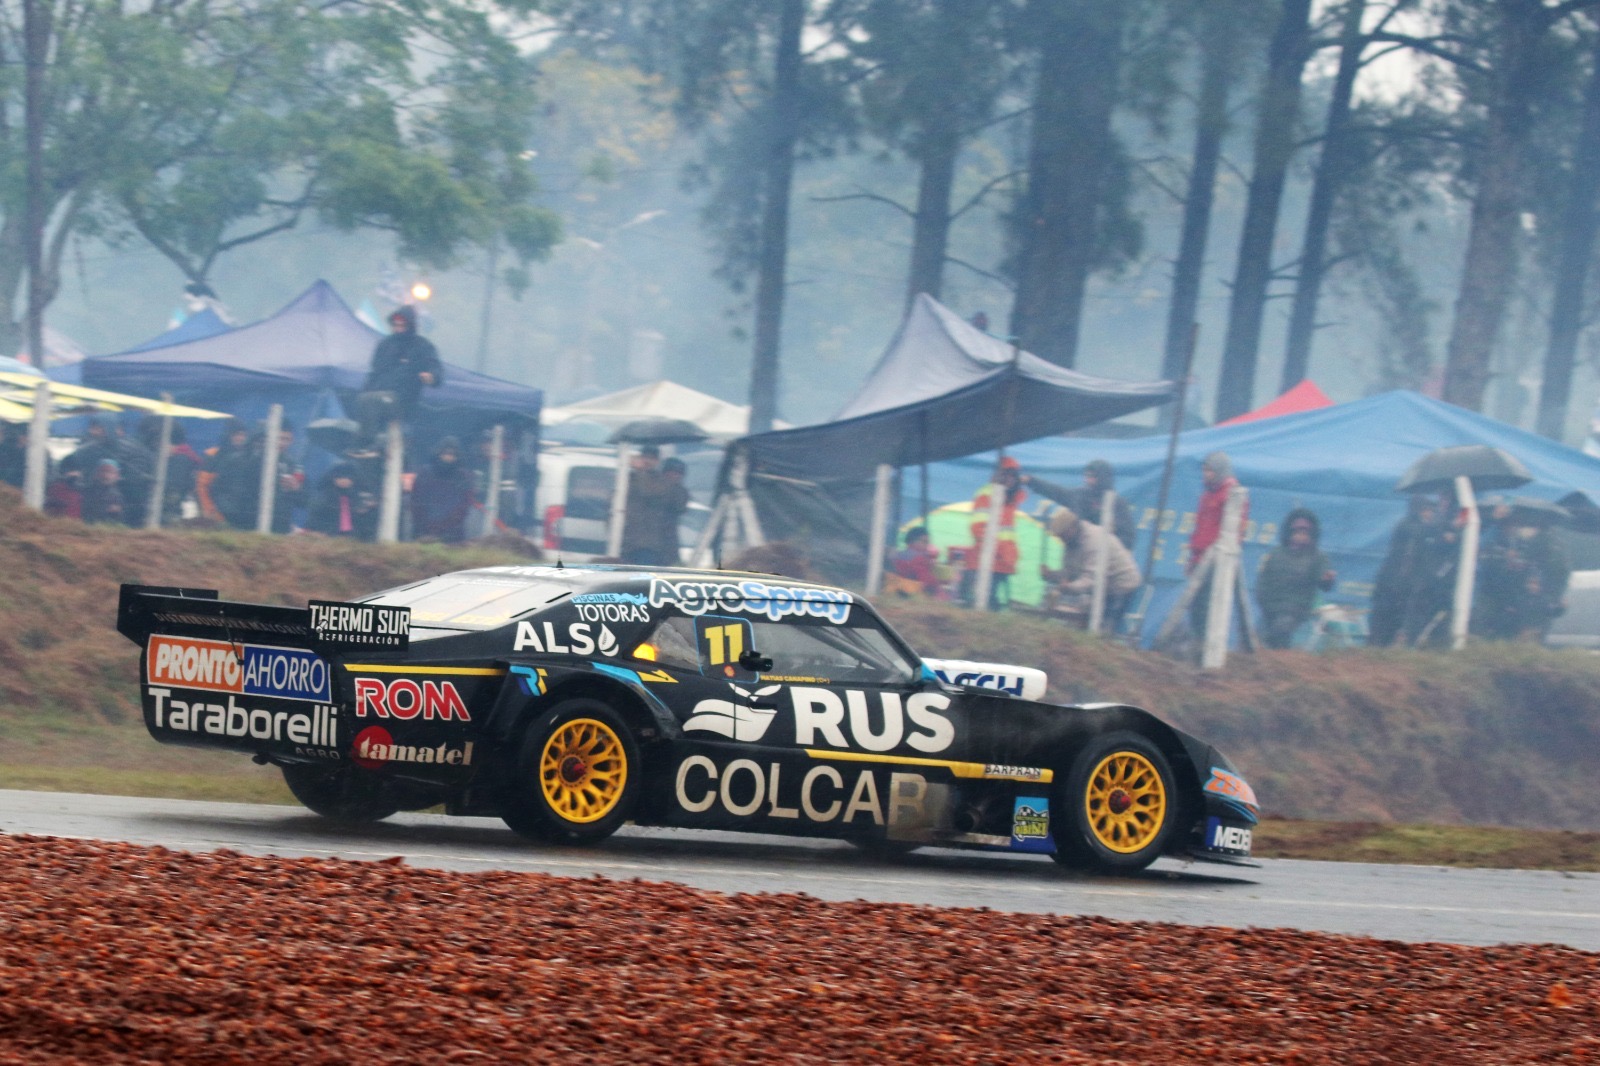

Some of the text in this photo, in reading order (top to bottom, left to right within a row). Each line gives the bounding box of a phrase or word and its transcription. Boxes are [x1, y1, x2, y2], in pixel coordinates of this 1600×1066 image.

[309, 604, 374, 633] THERMO
[377, 609, 410, 635] SUR
[572, 593, 616, 603] PISCINAS
[574, 603, 650, 624] TOTORAS
[650, 578, 852, 624] AgroSpray
[513, 620, 596, 656] ALS
[704, 623, 744, 666] 11
[155, 643, 327, 693] PRONTO AHORRO
[149, 686, 338, 748] Taraborelli
[354, 677, 472, 722] ROM
[790, 685, 956, 754] RUS
[358, 736, 474, 766] tamatel
[675, 754, 929, 828] COLCAR
